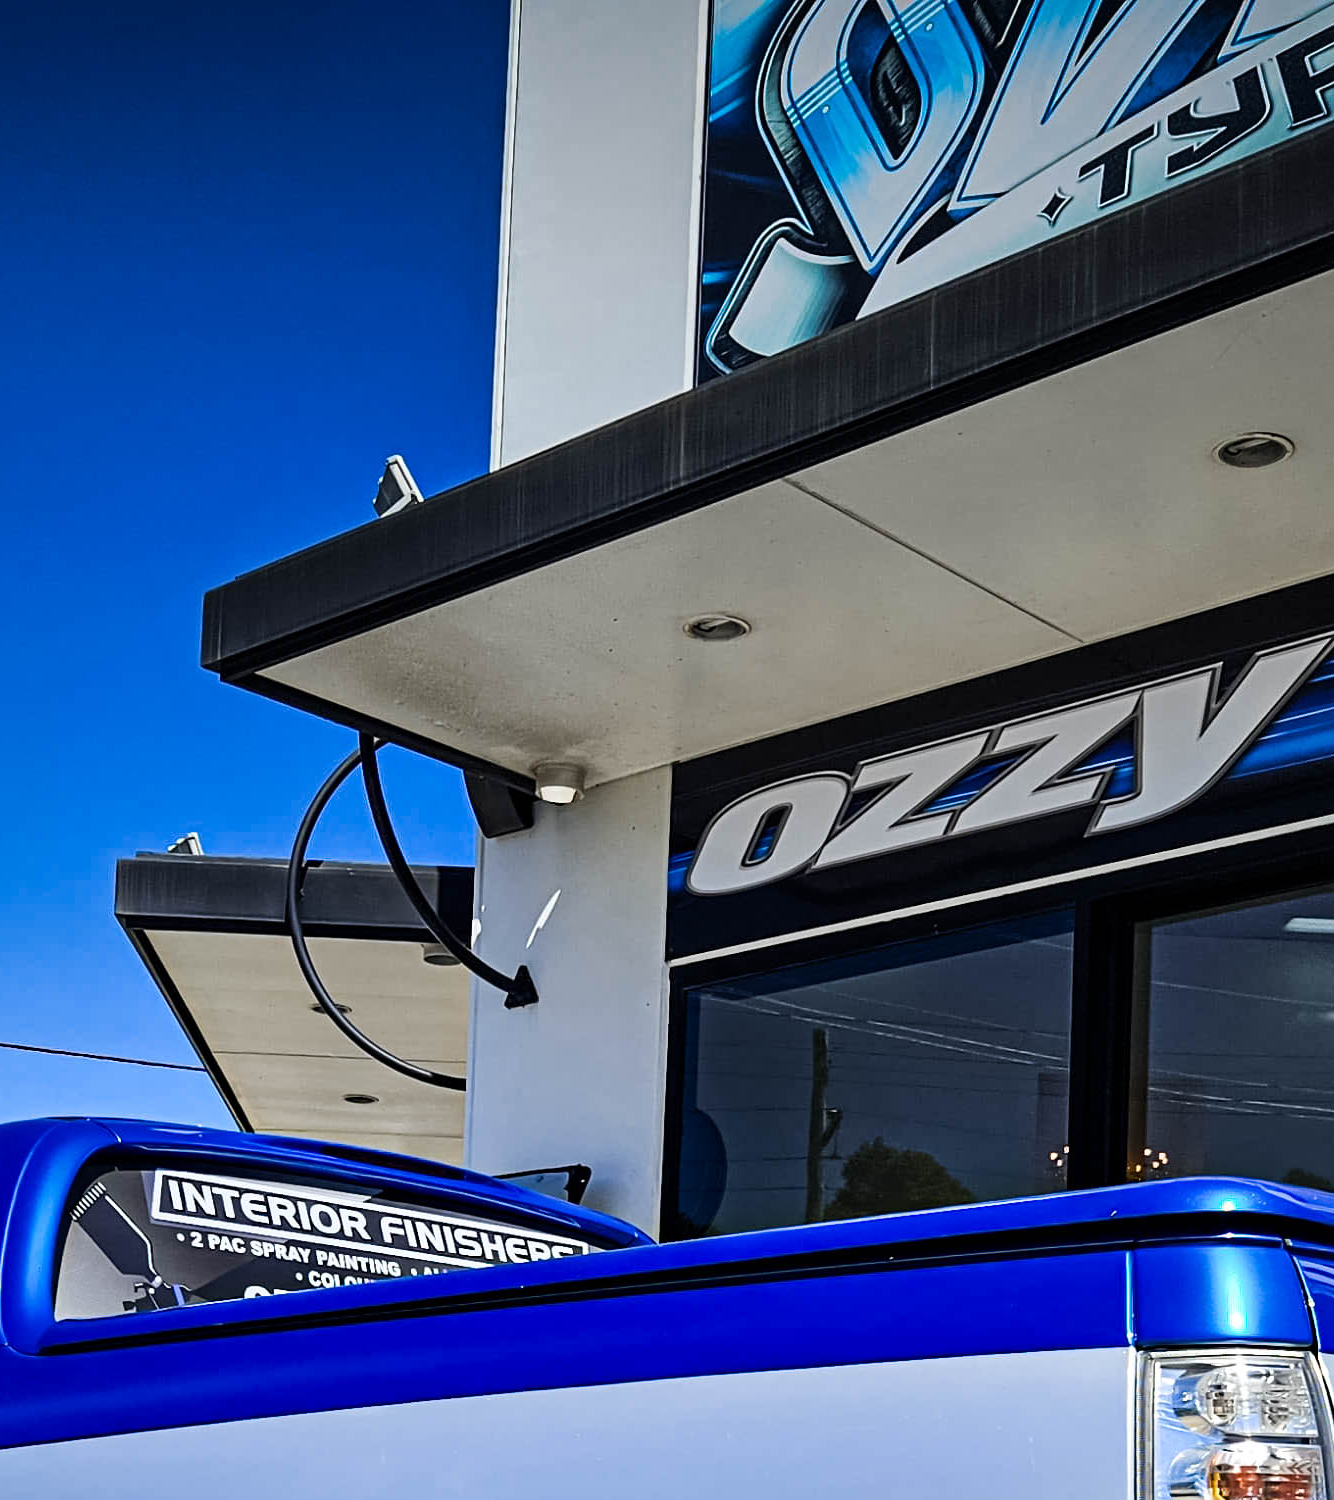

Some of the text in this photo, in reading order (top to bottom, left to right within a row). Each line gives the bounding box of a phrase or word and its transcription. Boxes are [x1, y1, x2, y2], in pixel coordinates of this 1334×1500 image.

[168, 1179, 371, 1240] INTERIOR
[190, 1231, 204, 1248] 2
[208, 1233, 246, 1253] PAC
[250, 1240, 311, 1264] SPRAY
[316, 1249, 402, 1277] PAINTING
